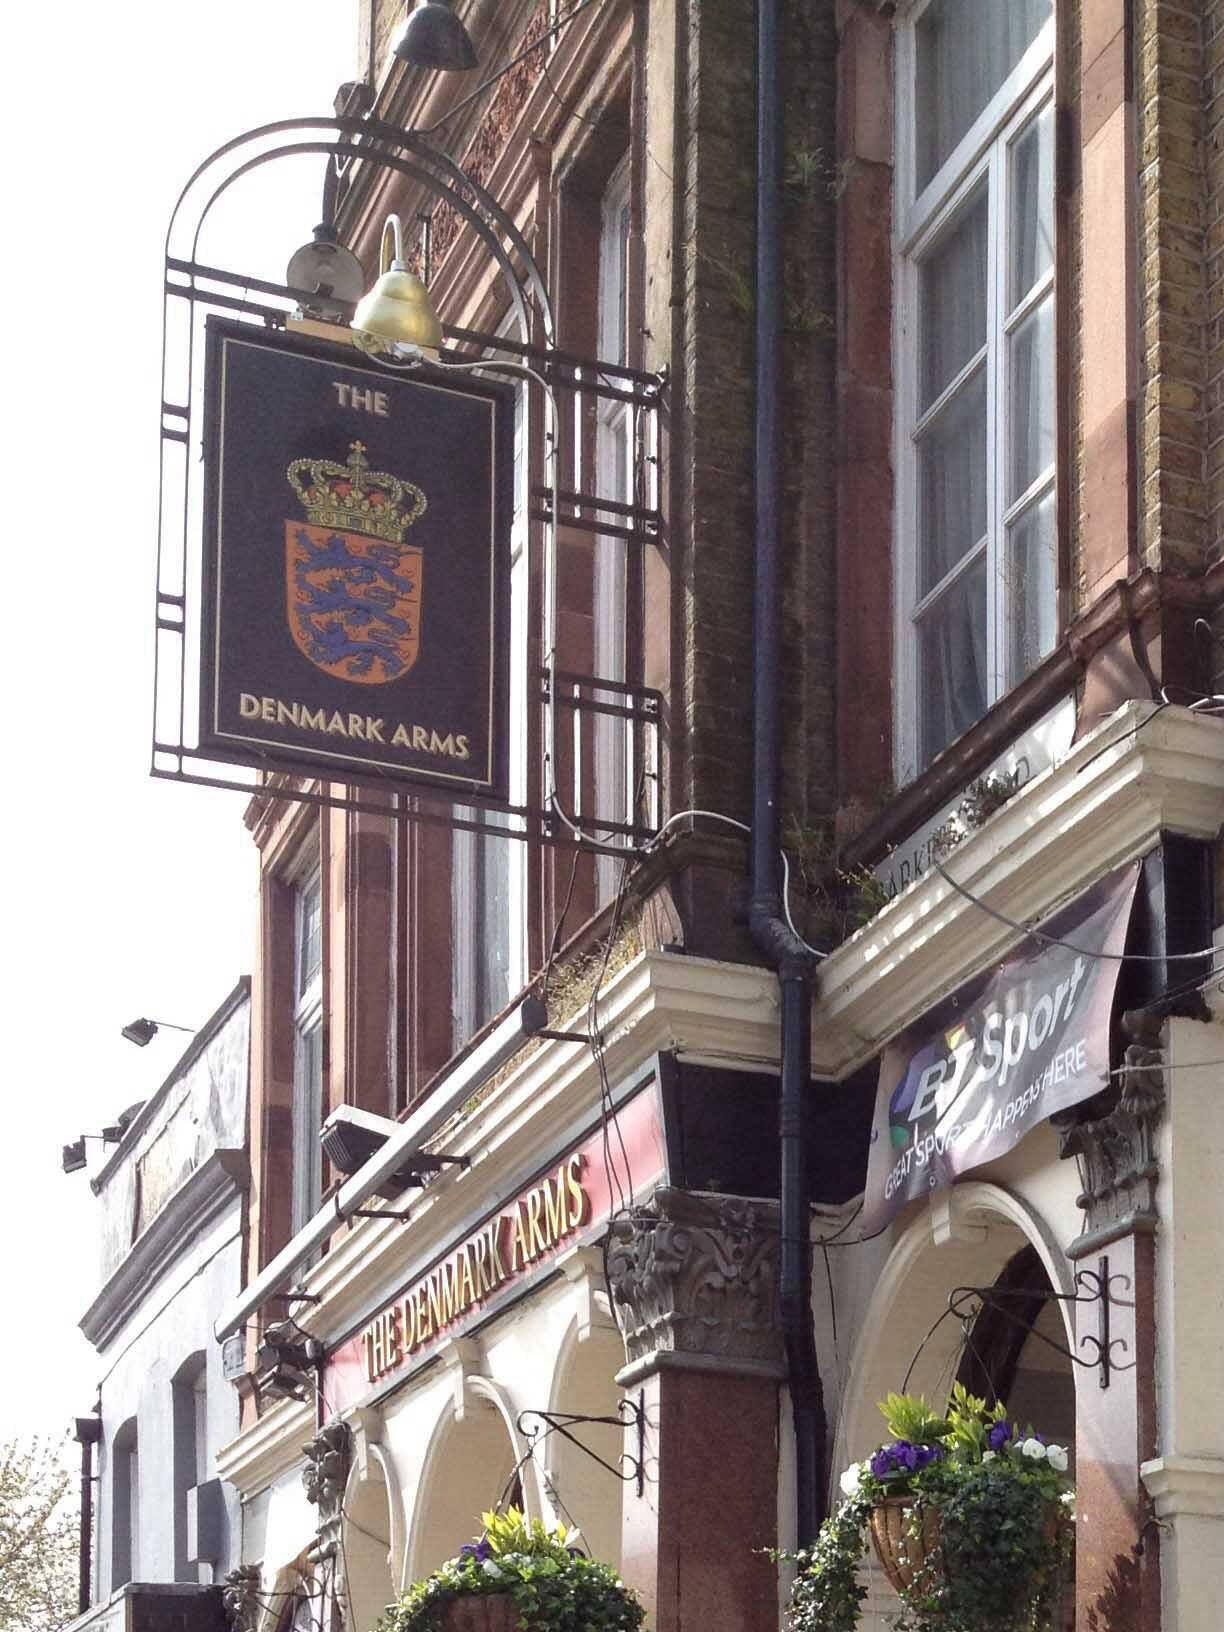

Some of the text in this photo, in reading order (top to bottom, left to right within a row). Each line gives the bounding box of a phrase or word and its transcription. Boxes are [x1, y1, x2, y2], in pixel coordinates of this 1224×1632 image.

[332, 381, 391, 417] THE
[239, 692, 471, 761] DENMARK ARMS
[884, 1146, 914, 1200] GREAT
[1041, 1038, 1087, 1091] HERE
[908, 956, 1086, 1122] BT Sport
[361, 1153, 590, 1384] THE DENMARK ARMS
